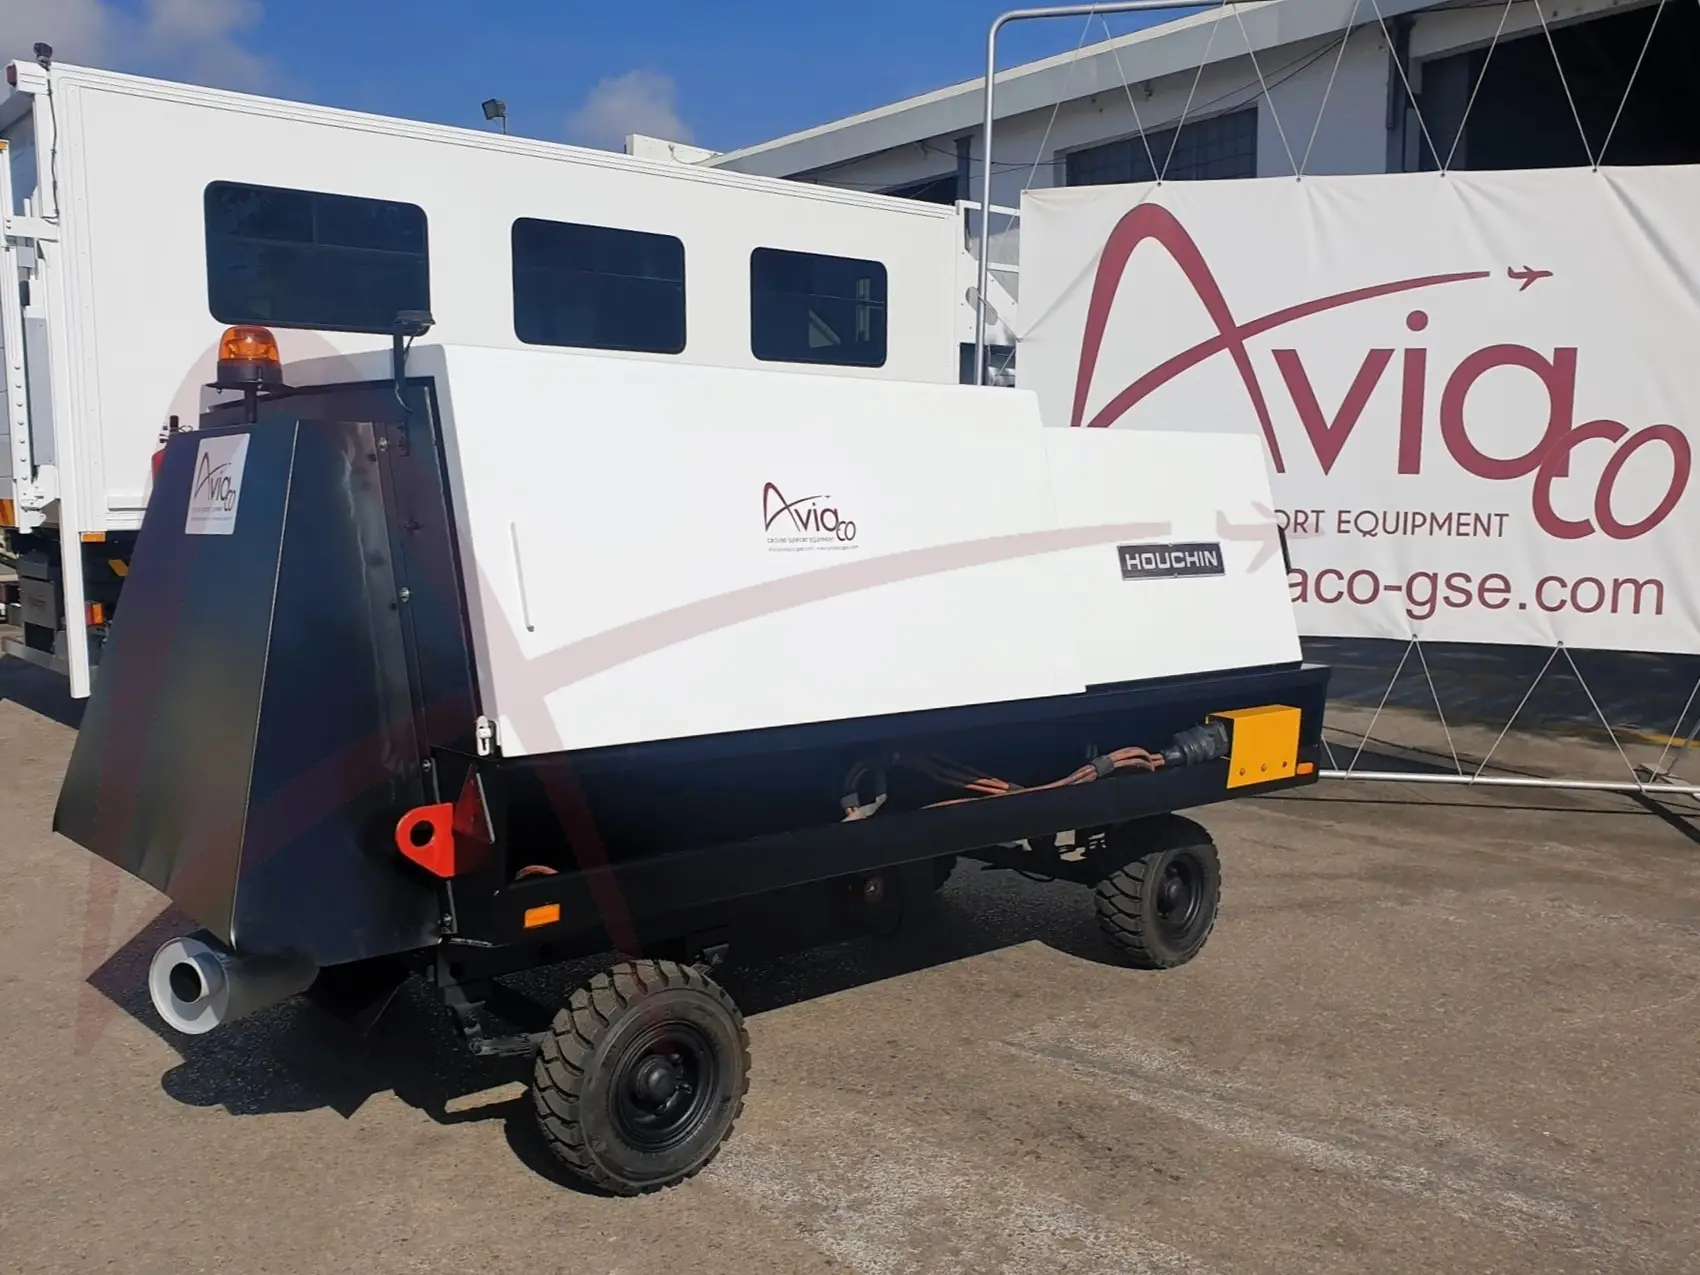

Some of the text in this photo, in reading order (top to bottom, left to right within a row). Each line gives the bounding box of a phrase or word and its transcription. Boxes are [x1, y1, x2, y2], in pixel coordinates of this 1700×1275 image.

[1337, 510, 1509, 538] EQUIPMENT
[1125, 550, 1219, 571] HOUCHIN
[1287, 568, 1665, 620] aco-gse.com
